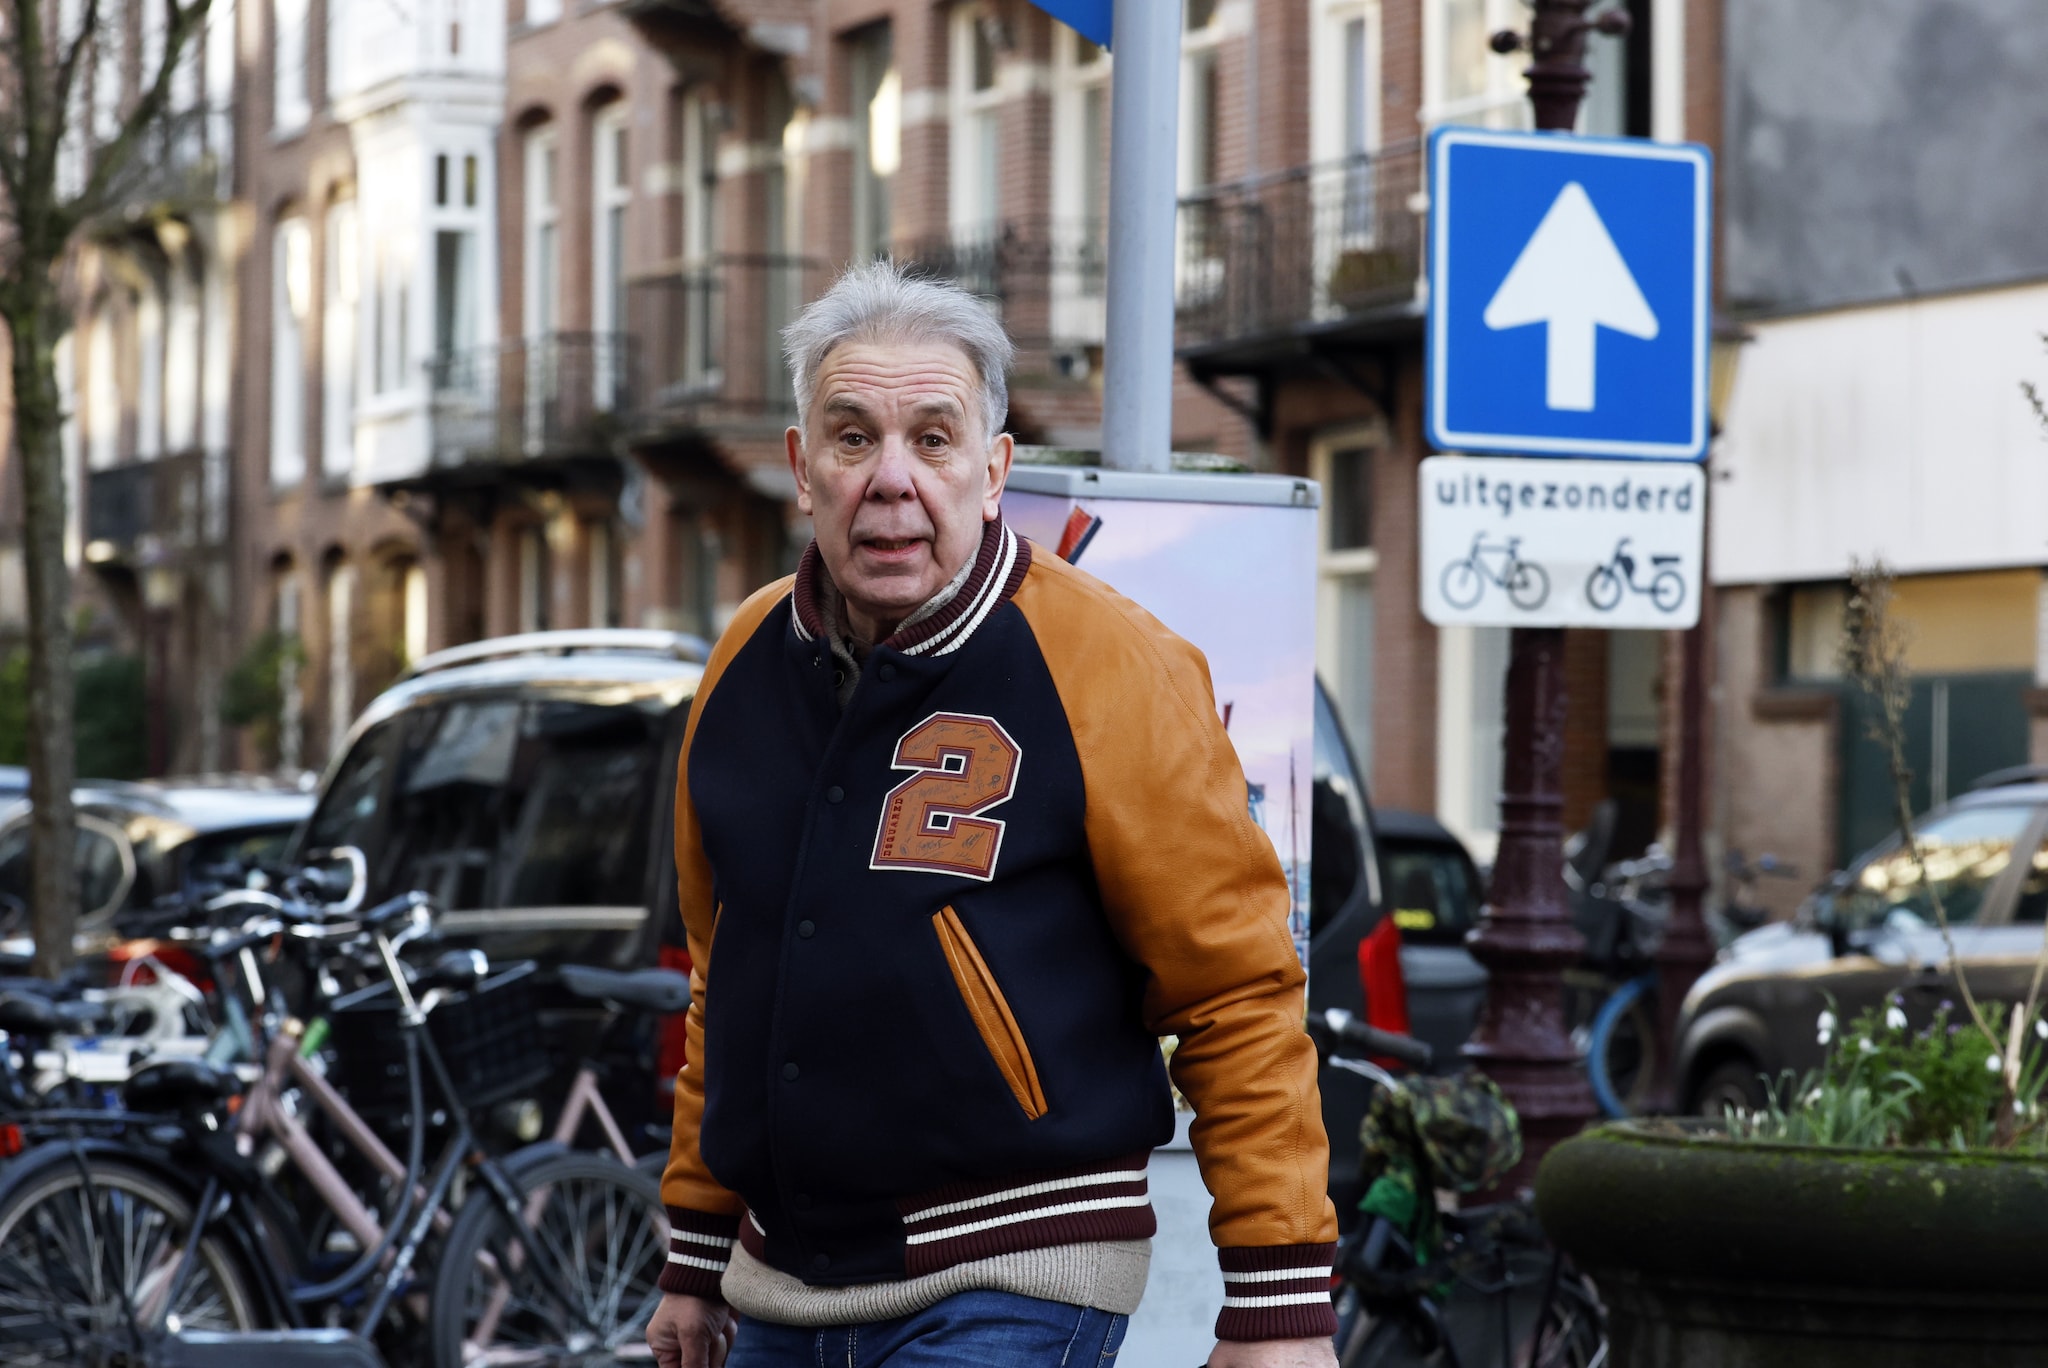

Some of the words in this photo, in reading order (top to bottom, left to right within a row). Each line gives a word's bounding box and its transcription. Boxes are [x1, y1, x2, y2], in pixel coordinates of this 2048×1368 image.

[1436, 475, 1694, 516] uitgezonderd
[869, 711, 1022, 881] 2
[883, 798, 903, 857] DSQUARED
